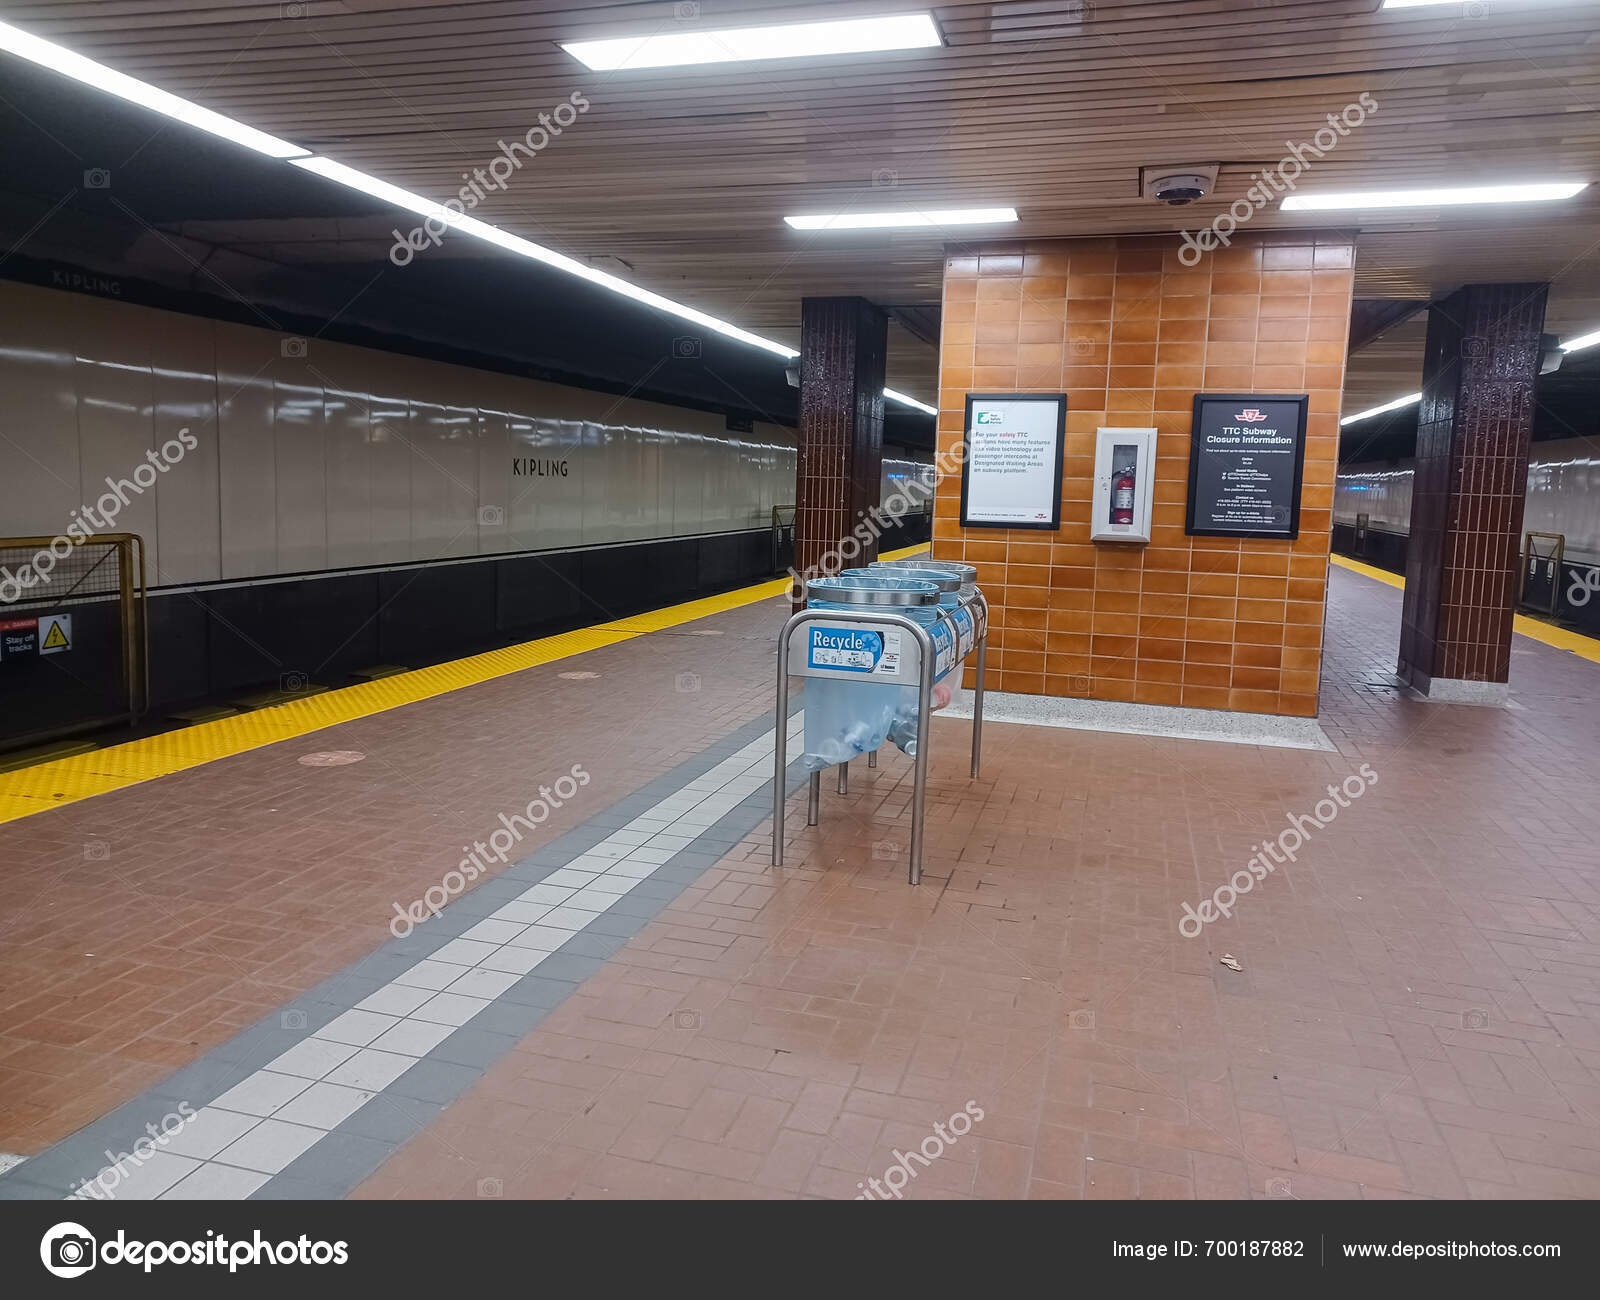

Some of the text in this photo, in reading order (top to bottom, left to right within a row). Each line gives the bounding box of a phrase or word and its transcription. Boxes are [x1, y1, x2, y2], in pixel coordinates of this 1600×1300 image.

[53, 270, 121, 295] KIPLING
[999, 431, 1016, 439] safety
[1222, 427, 1277, 437] TTC Subway
[1206, 435, 1292, 444] Closure Information
[513, 458, 568, 477] KIPLING
[6, 634, 35, 645] Stay off
[813, 630, 864, 654] Recycle
[9, 644, 33, 653] tracks
